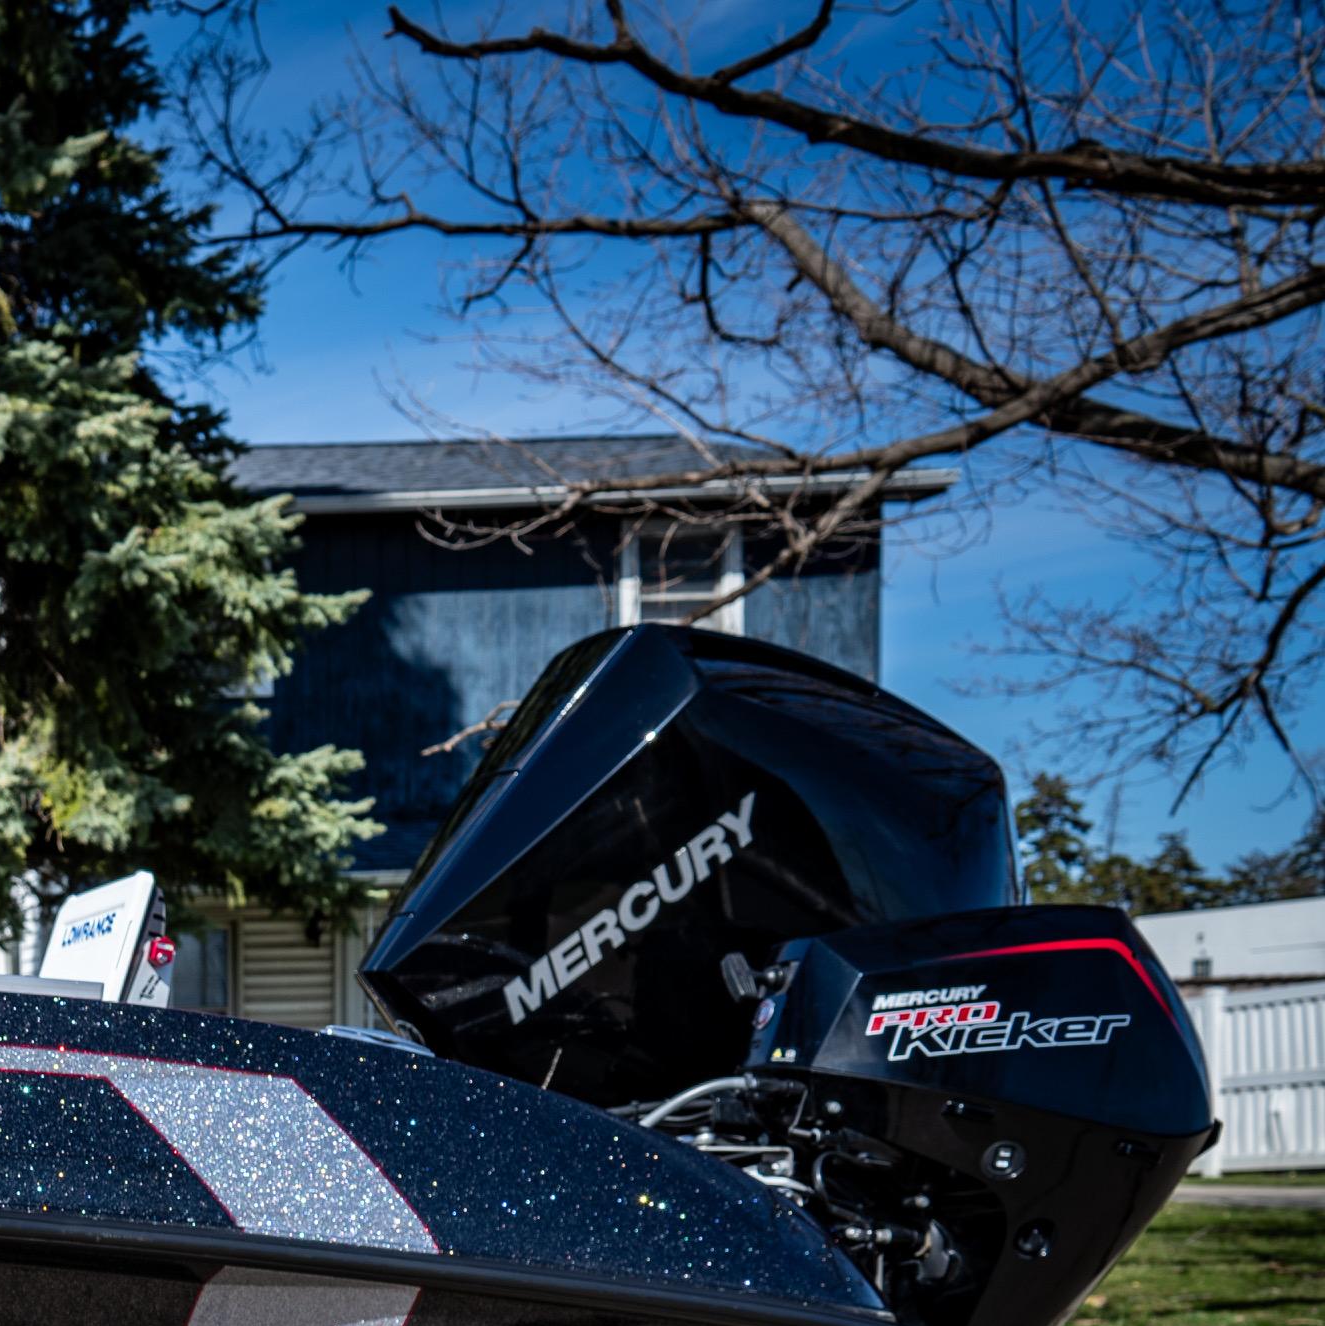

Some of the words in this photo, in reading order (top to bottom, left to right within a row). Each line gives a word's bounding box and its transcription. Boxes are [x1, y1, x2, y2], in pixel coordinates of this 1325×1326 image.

[503, 791, 755, 1025] MERCURY
[873, 985, 986, 1011] MERCURY
[865, 1001, 1000, 1036] PRO
